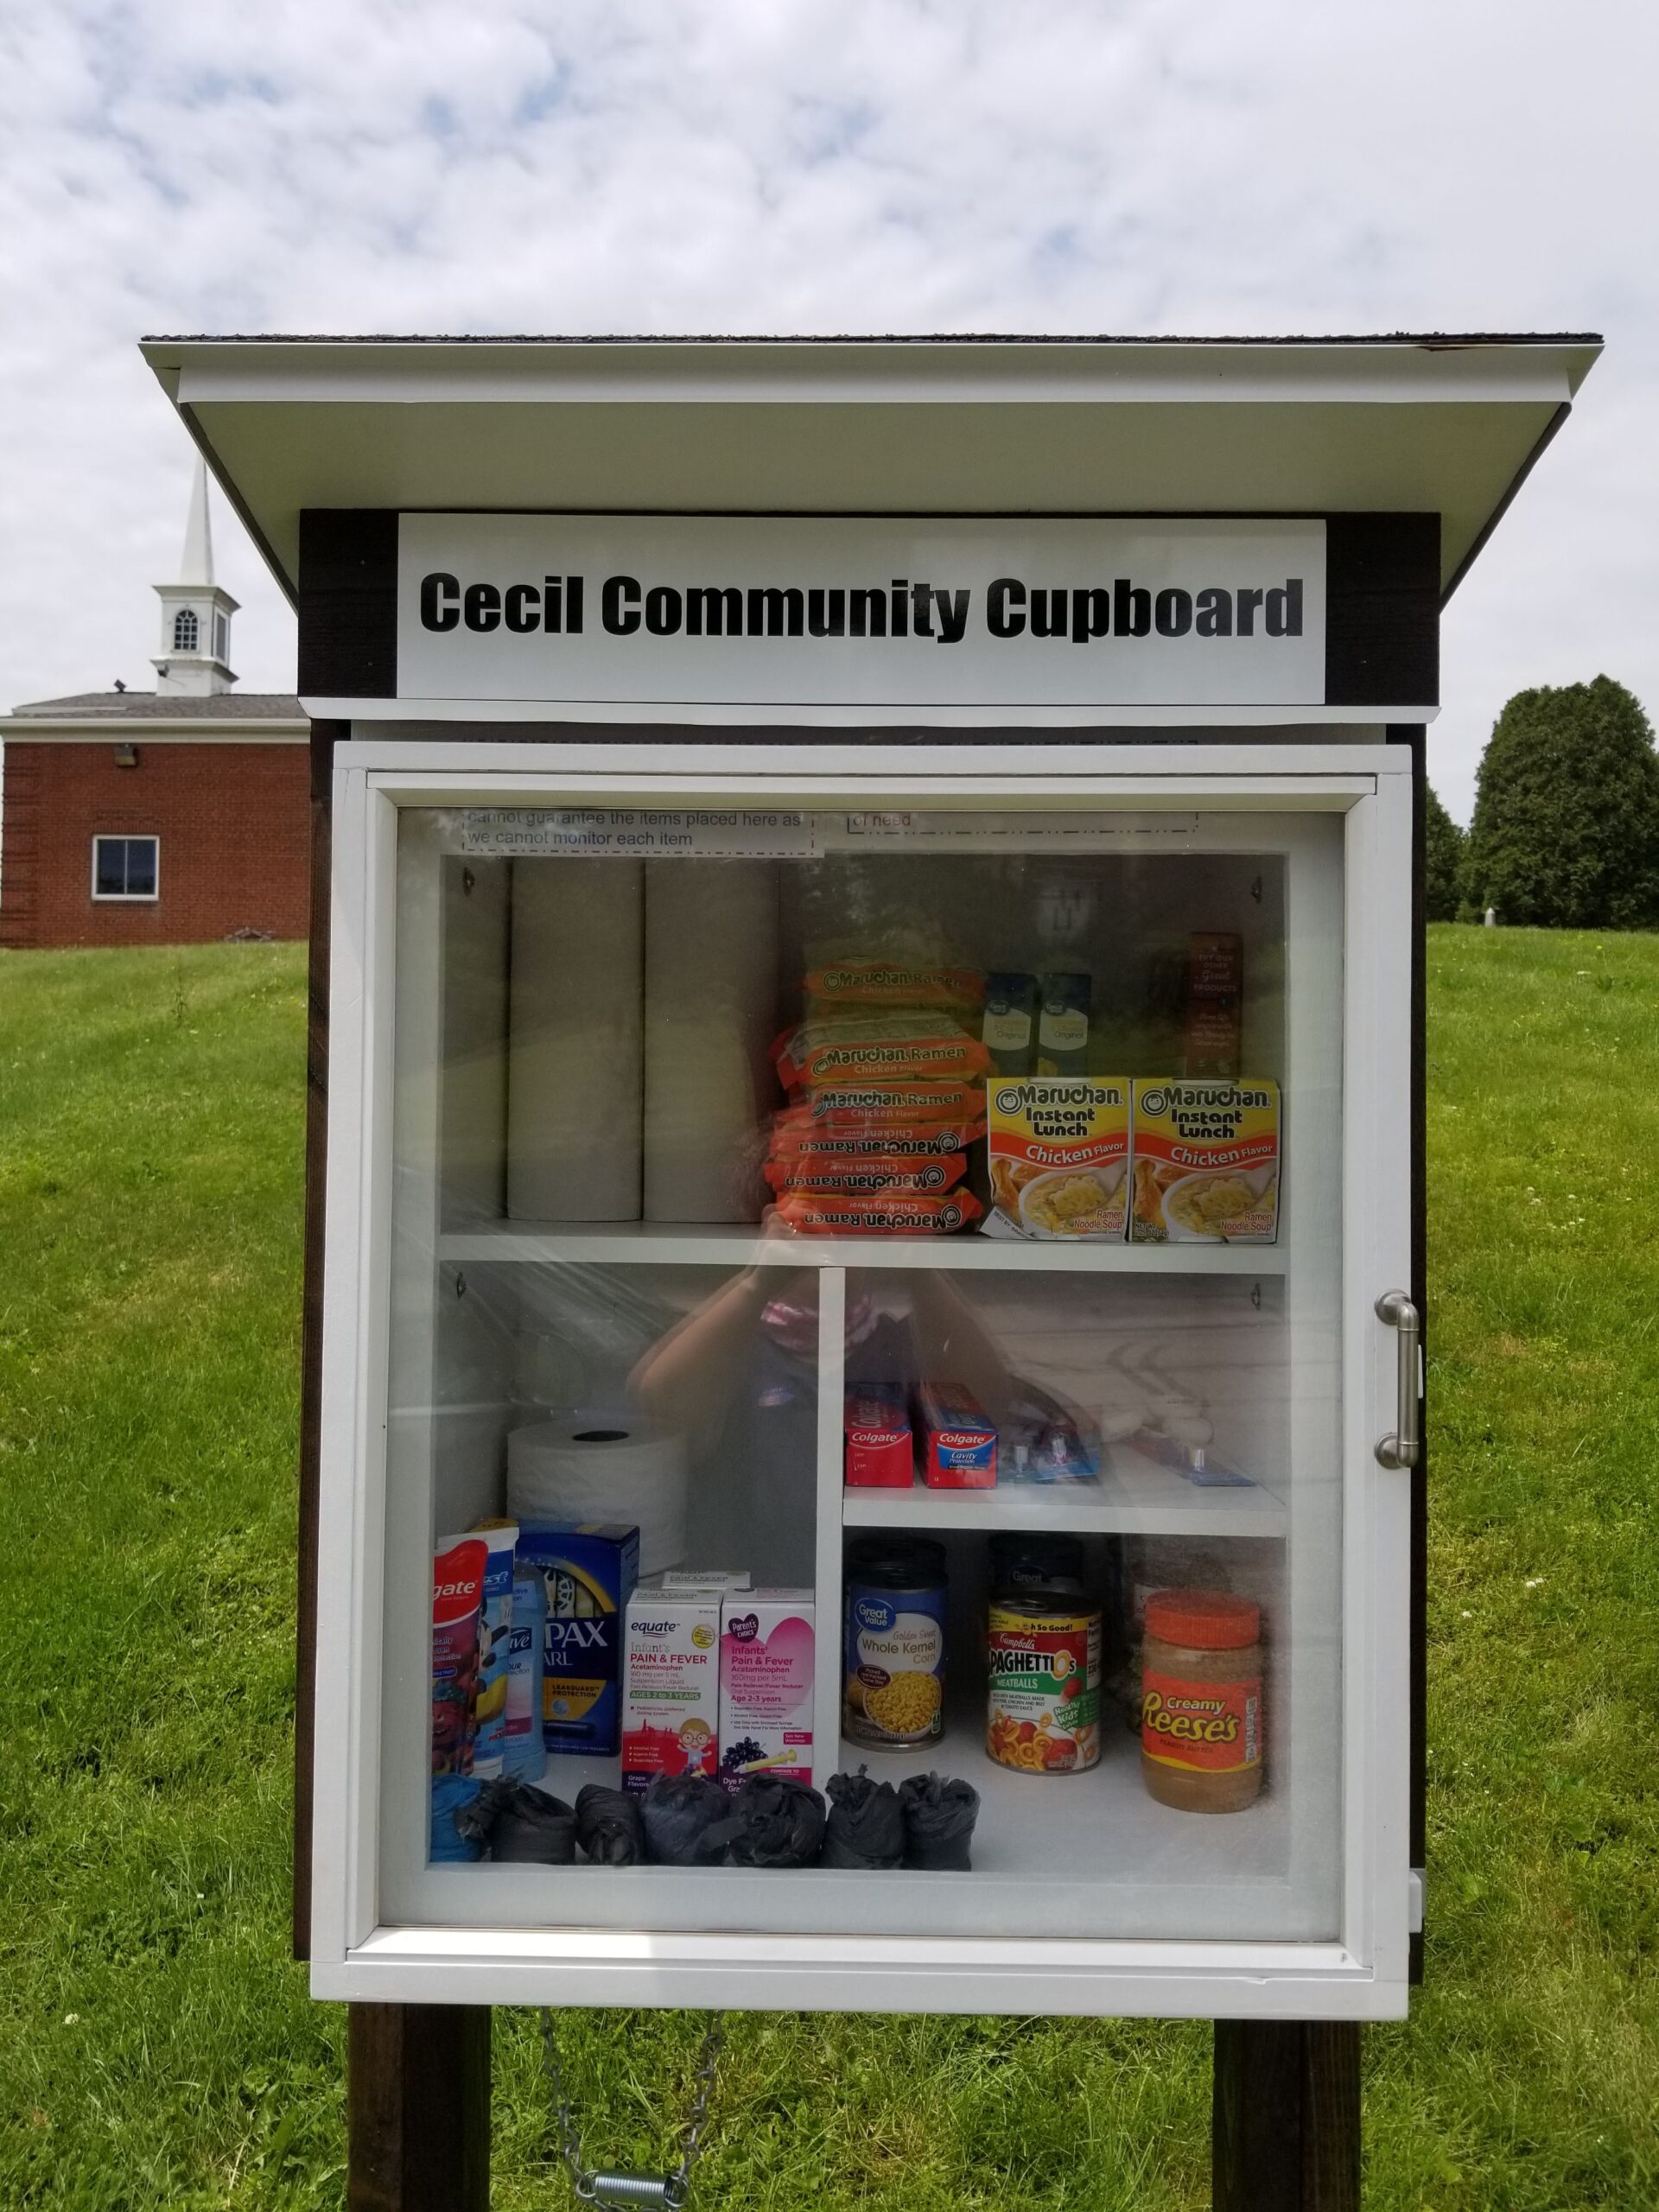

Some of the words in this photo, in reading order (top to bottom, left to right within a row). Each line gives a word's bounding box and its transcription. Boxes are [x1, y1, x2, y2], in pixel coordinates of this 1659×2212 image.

[419, 571, 584, 634] Cecil
[601, 575, 970, 644] Community
[986, 576, 1304, 644] Cupboard
[610, 810, 635, 825] the
[639, 811, 681, 825] items
[686, 812, 737, 829] placed
[743, 812, 777, 826] here
[782, 814, 801, 826] as
[873, 812, 911, 825] need
[467, 832, 490, 844] we
[496, 830, 548, 844] cannot
[554, 830, 611, 846] monitor
[617, 832, 655, 846] each
[659, 832, 693, 846] item
[840, 970, 909, 987] Maruchan
[826, 1047, 909, 1065] Maruchan
[910, 1047, 967, 1061] Ramen
[851, 1064, 895, 1074] Chicken
[823, 1090, 906, 1108] Maruchan
[907, 1091, 964, 1105] Ramen
[1016, 1084, 1121, 1106] Maruchan
[1162, 1085, 1268, 1108] Maruchan
[850, 1108, 893, 1117] Chicken
[1026, 1107, 1096, 1122] Instant
[1171, 1109, 1243, 1124] Instant
[1033, 1122, 1088, 1137] Lunch
[1179, 1123, 1235, 1139] Lunch
[798, 1140, 857, 1154] Ramen
[859, 1138, 943, 1155] Maruchan
[1025, 1144, 1094, 1165] Chicken
[1094, 1141, 1124, 1155] Flavor
[1170, 1146, 1241, 1166] Chicken
[1241, 1145, 1273, 1158] Flavor
[785, 1175, 844, 1187] Ramen
[846, 1173, 929, 1191] Maruchan
[804, 1212, 862, 1226] Ramen
[864, 1212, 947, 1230] Maruchan
[1096, 1210, 1122, 1219] Ramen
[1244, 1211, 1272, 1221] Ramen
[1073, 1218, 1102, 1230] Noodle
[1102, 1218, 1122, 1230] Soup
[1221, 1220, 1249, 1231] Noodle
[1249, 1220, 1272, 1231] Soup
[851, 1432, 898, 1444] Colgate
[939, 1433, 986, 1445] Colgate
[951, 1451, 977, 1460] Cavity
[1013, 1570, 1043, 1584] Great
[859, 1603, 887, 1618] Great
[631, 1621, 677, 1634] equate
[732, 1618, 757, 1631] Parent's
[865, 1616, 887, 1626] Value
[1049, 1624, 1072, 1632] Good!
[893, 1630, 918, 1641] Golden
[1000, 1631, 1035, 1650] Campbell's
[631, 1642, 671, 1653] infant's
[732, 1645, 768, 1655] Infants'
[861, 1638, 899, 1654] Whole
[903, 1639, 936, 1654] Kernel
[631, 1653, 657, 1662] PAIN
[660, 1654, 667, 1663] &
[671, 1655, 708, 1664] FEVER
[732, 1656, 753, 1665] Pain
[755, 1656, 763, 1665] &
[766, 1656, 794, 1666] Fever
[913, 1654, 936, 1664] Corn
[631, 1663, 683, 1672] Acetaminophen
[731, 1665, 790, 1675] Acetaminophen
[997, 1677, 1038, 1690] MEATBALLS
[730, 1694, 746, 1703] Age
[761, 1695, 782, 1704] years
[1166, 1696, 1227, 1715] Creamy
[1058, 1710, 1079, 1726] Kids
[1141, 1691, 1240, 1742] Reese's
[723, 1777, 737, 1786] Dye
